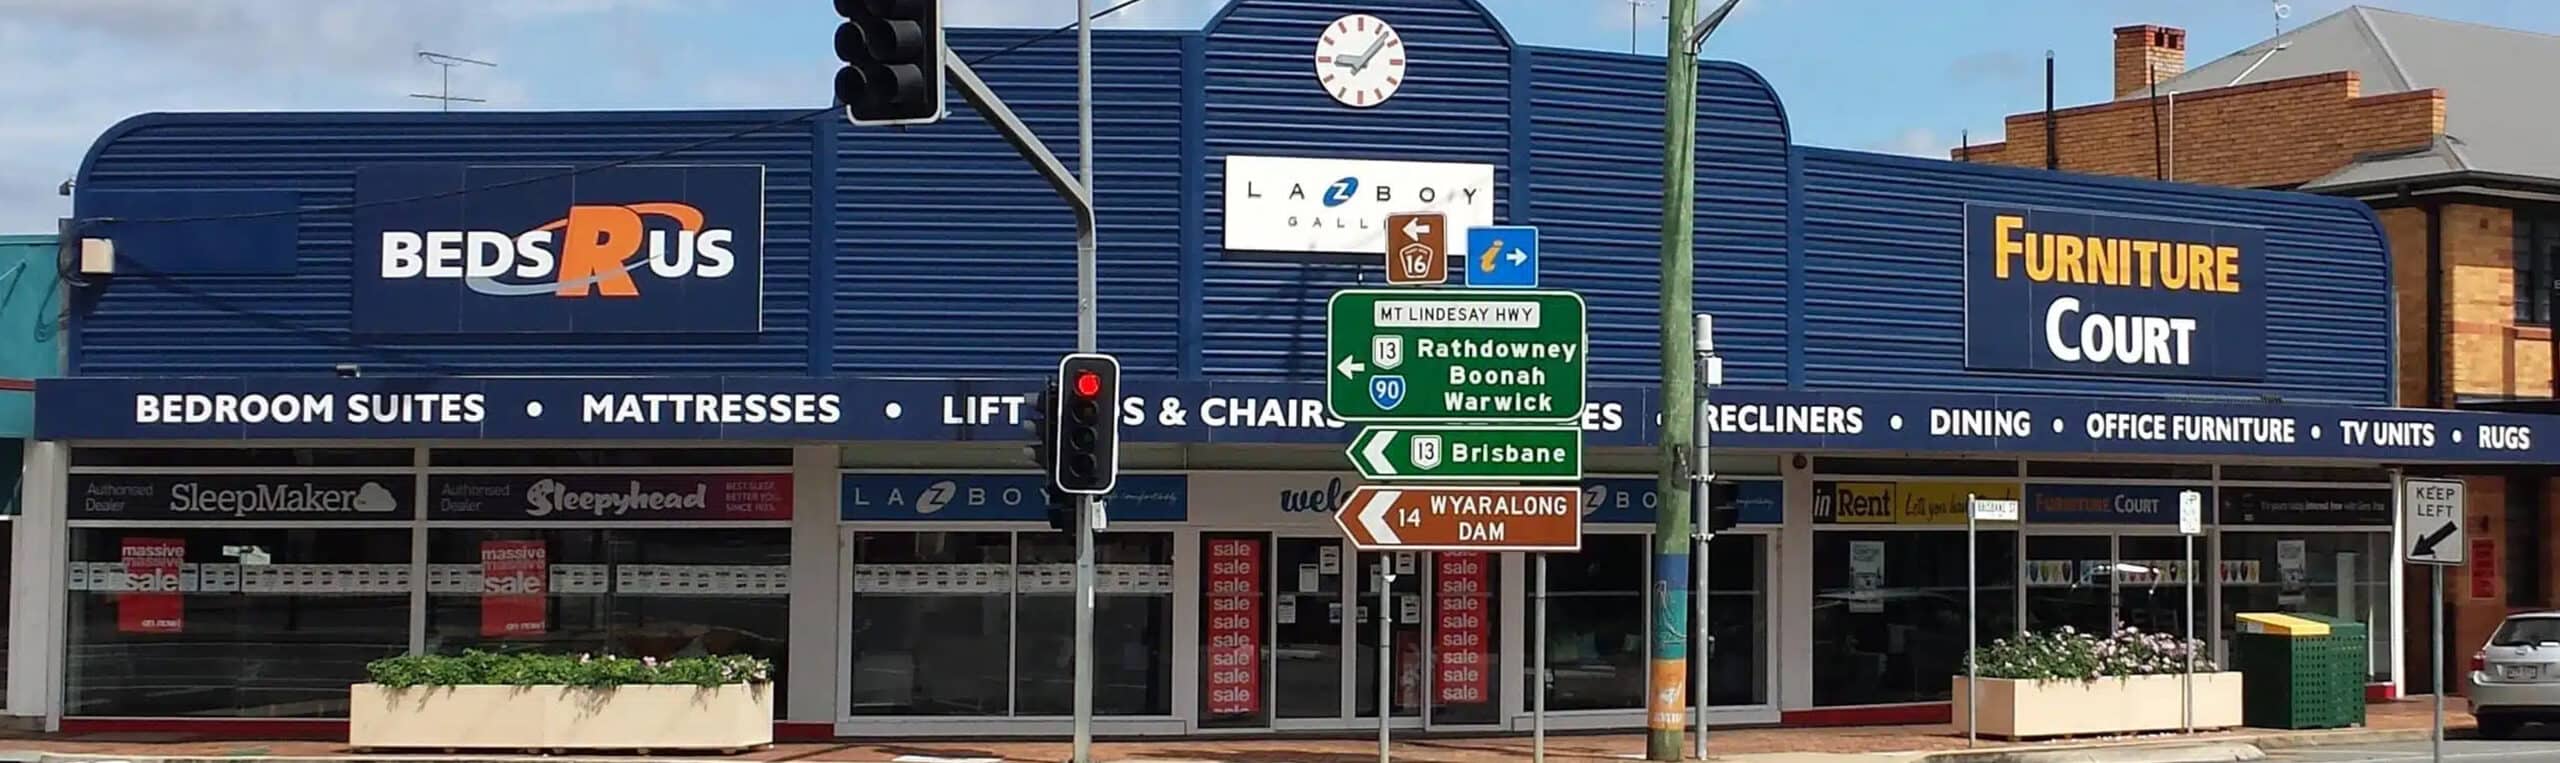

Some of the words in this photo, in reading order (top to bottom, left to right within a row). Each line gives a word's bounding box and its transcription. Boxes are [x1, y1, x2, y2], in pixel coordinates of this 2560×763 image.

[1287, 216, 1387, 230] GALL
[381, 231, 554, 278] BEDS
[649, 230, 734, 278] US
[1995, 215, 2240, 292] FURNITURE
[1404, 254, 1427, 273] 16
[1380, 307, 1403, 321] MT
[1409, 307, 1489, 322] LINDESAY
[1495, 307, 1533, 322] HWY
[2045, 296, 2196, 365] COURT
[1378, 341, 1396, 360] 13
[1417, 338, 1577, 363] Rathdowney
[1450, 366, 1546, 385] Boonah
[1374, 380, 1400, 400] 90
[136, 394, 333, 423] BEDROOM
[347, 394, 485, 423] SUITES
[582, 394, 841, 423] MATTRESSES
[943, 396, 1025, 425] LIFT
[1159, 397, 1187, 425] &
[1444, 392, 1553, 412] Warwick
[1707, 404, 1863, 434] RECLINERS
[1930, 408, 2031, 436] DINING
[2086, 412, 2166, 440] OFFICE
[2172, 415, 2295, 443] FURNITURE
[2340, 419, 2369, 445] TV
[2373, 421, 2435, 448] UNITS
[2478, 425, 2531, 450] RUGS
[1418, 441, 1434, 460] 13
[1452, 444, 1566, 463] Brisbane
[169, 483, 356, 517] SleepMaker
[526, 478, 707, 517] Sleepyhead
[1813, 489, 1832, 517] in
[1838, 489, 1891, 516] Rent
[2416, 487, 2455, 500] KEEP
[1398, 508, 1421, 527] 14
[1430, 495, 1568, 515] WYARALONG
[2114, 494, 2161, 513] COURT
[2417, 504, 2453, 517] LEFT
[1458, 522, 1505, 541] DAM
[122, 543, 185, 557] massive
[481, 545, 545, 560] massive
[1213, 541, 1250, 556] sale
[1213, 559, 1250, 574] sale
[1443, 559, 1479, 574] sale
[125, 568, 179, 592] sale
[484, 570, 541, 593] sale
[1213, 577, 1250, 592] sale
[1443, 577, 1479, 592] sale
[1213, 595, 1250, 611] sale
[1443, 595, 1479, 610] sale
[1213, 614, 1250, 629] sale
[1443, 614, 1479, 628] sale
[1213, 632, 1250, 647] sale
[1443, 631, 1479, 646] sale
[1213, 650, 1250, 665] sale
[1443, 649, 1479, 664] sale
[1213, 668, 1250, 683] sale
[1443, 667, 1479, 682] sale
[1213, 686, 1250, 701] sale
[1443, 685, 1479, 700] sale
